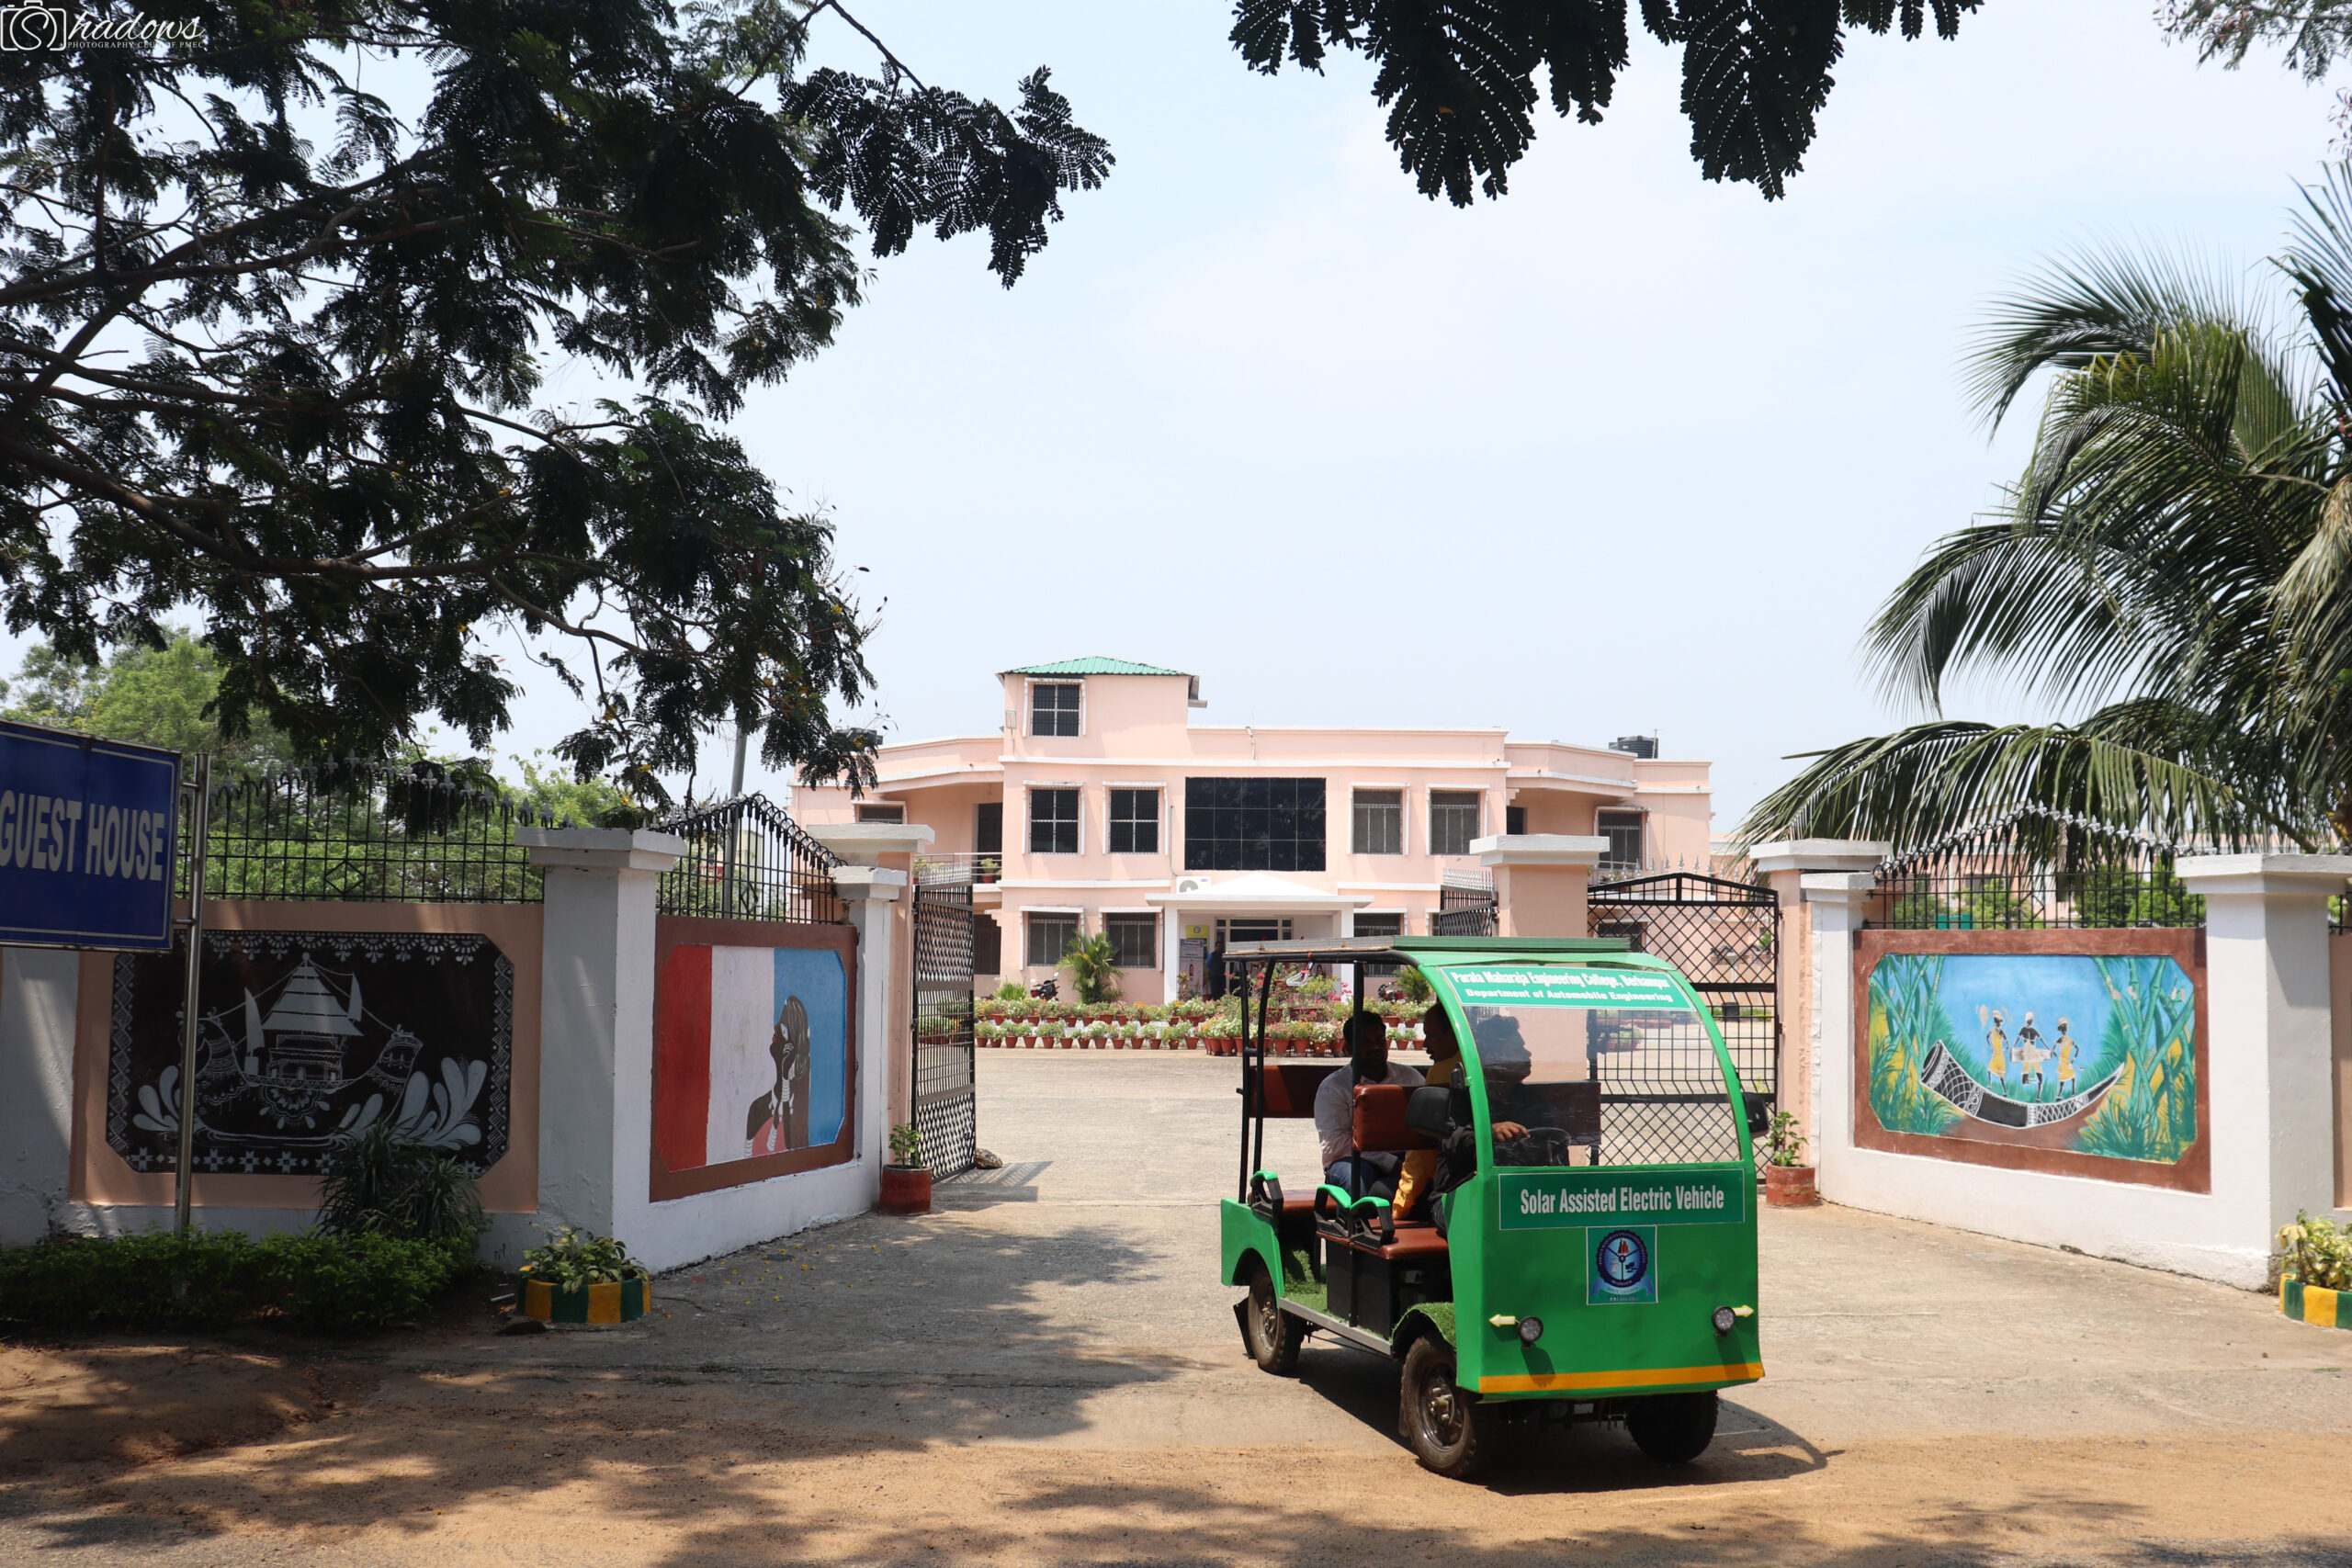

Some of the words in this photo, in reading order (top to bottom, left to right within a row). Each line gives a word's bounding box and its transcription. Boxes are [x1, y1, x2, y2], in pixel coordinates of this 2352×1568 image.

[0, 790, 82, 872] GUEST
[85, 803, 165, 881] HOUSE
[1450, 971, 1485, 984] Parala
[1482, 971, 1530, 987] Maharaja
[1527, 972, 1586, 987] Engineering
[1464, 988, 1531, 998] Department
[1532, 990, 1544, 998] of
[1546, 990, 1608, 999] Automobile
[1609, 991, 1674, 1002] Engineering
[1521, 1189, 1555, 1214] Solar
[1559, 1188, 1616, 1213] Assisted
[1620, 1186, 1671, 1212] Electric
[1675, 1185, 1724, 1210] Vehicle
